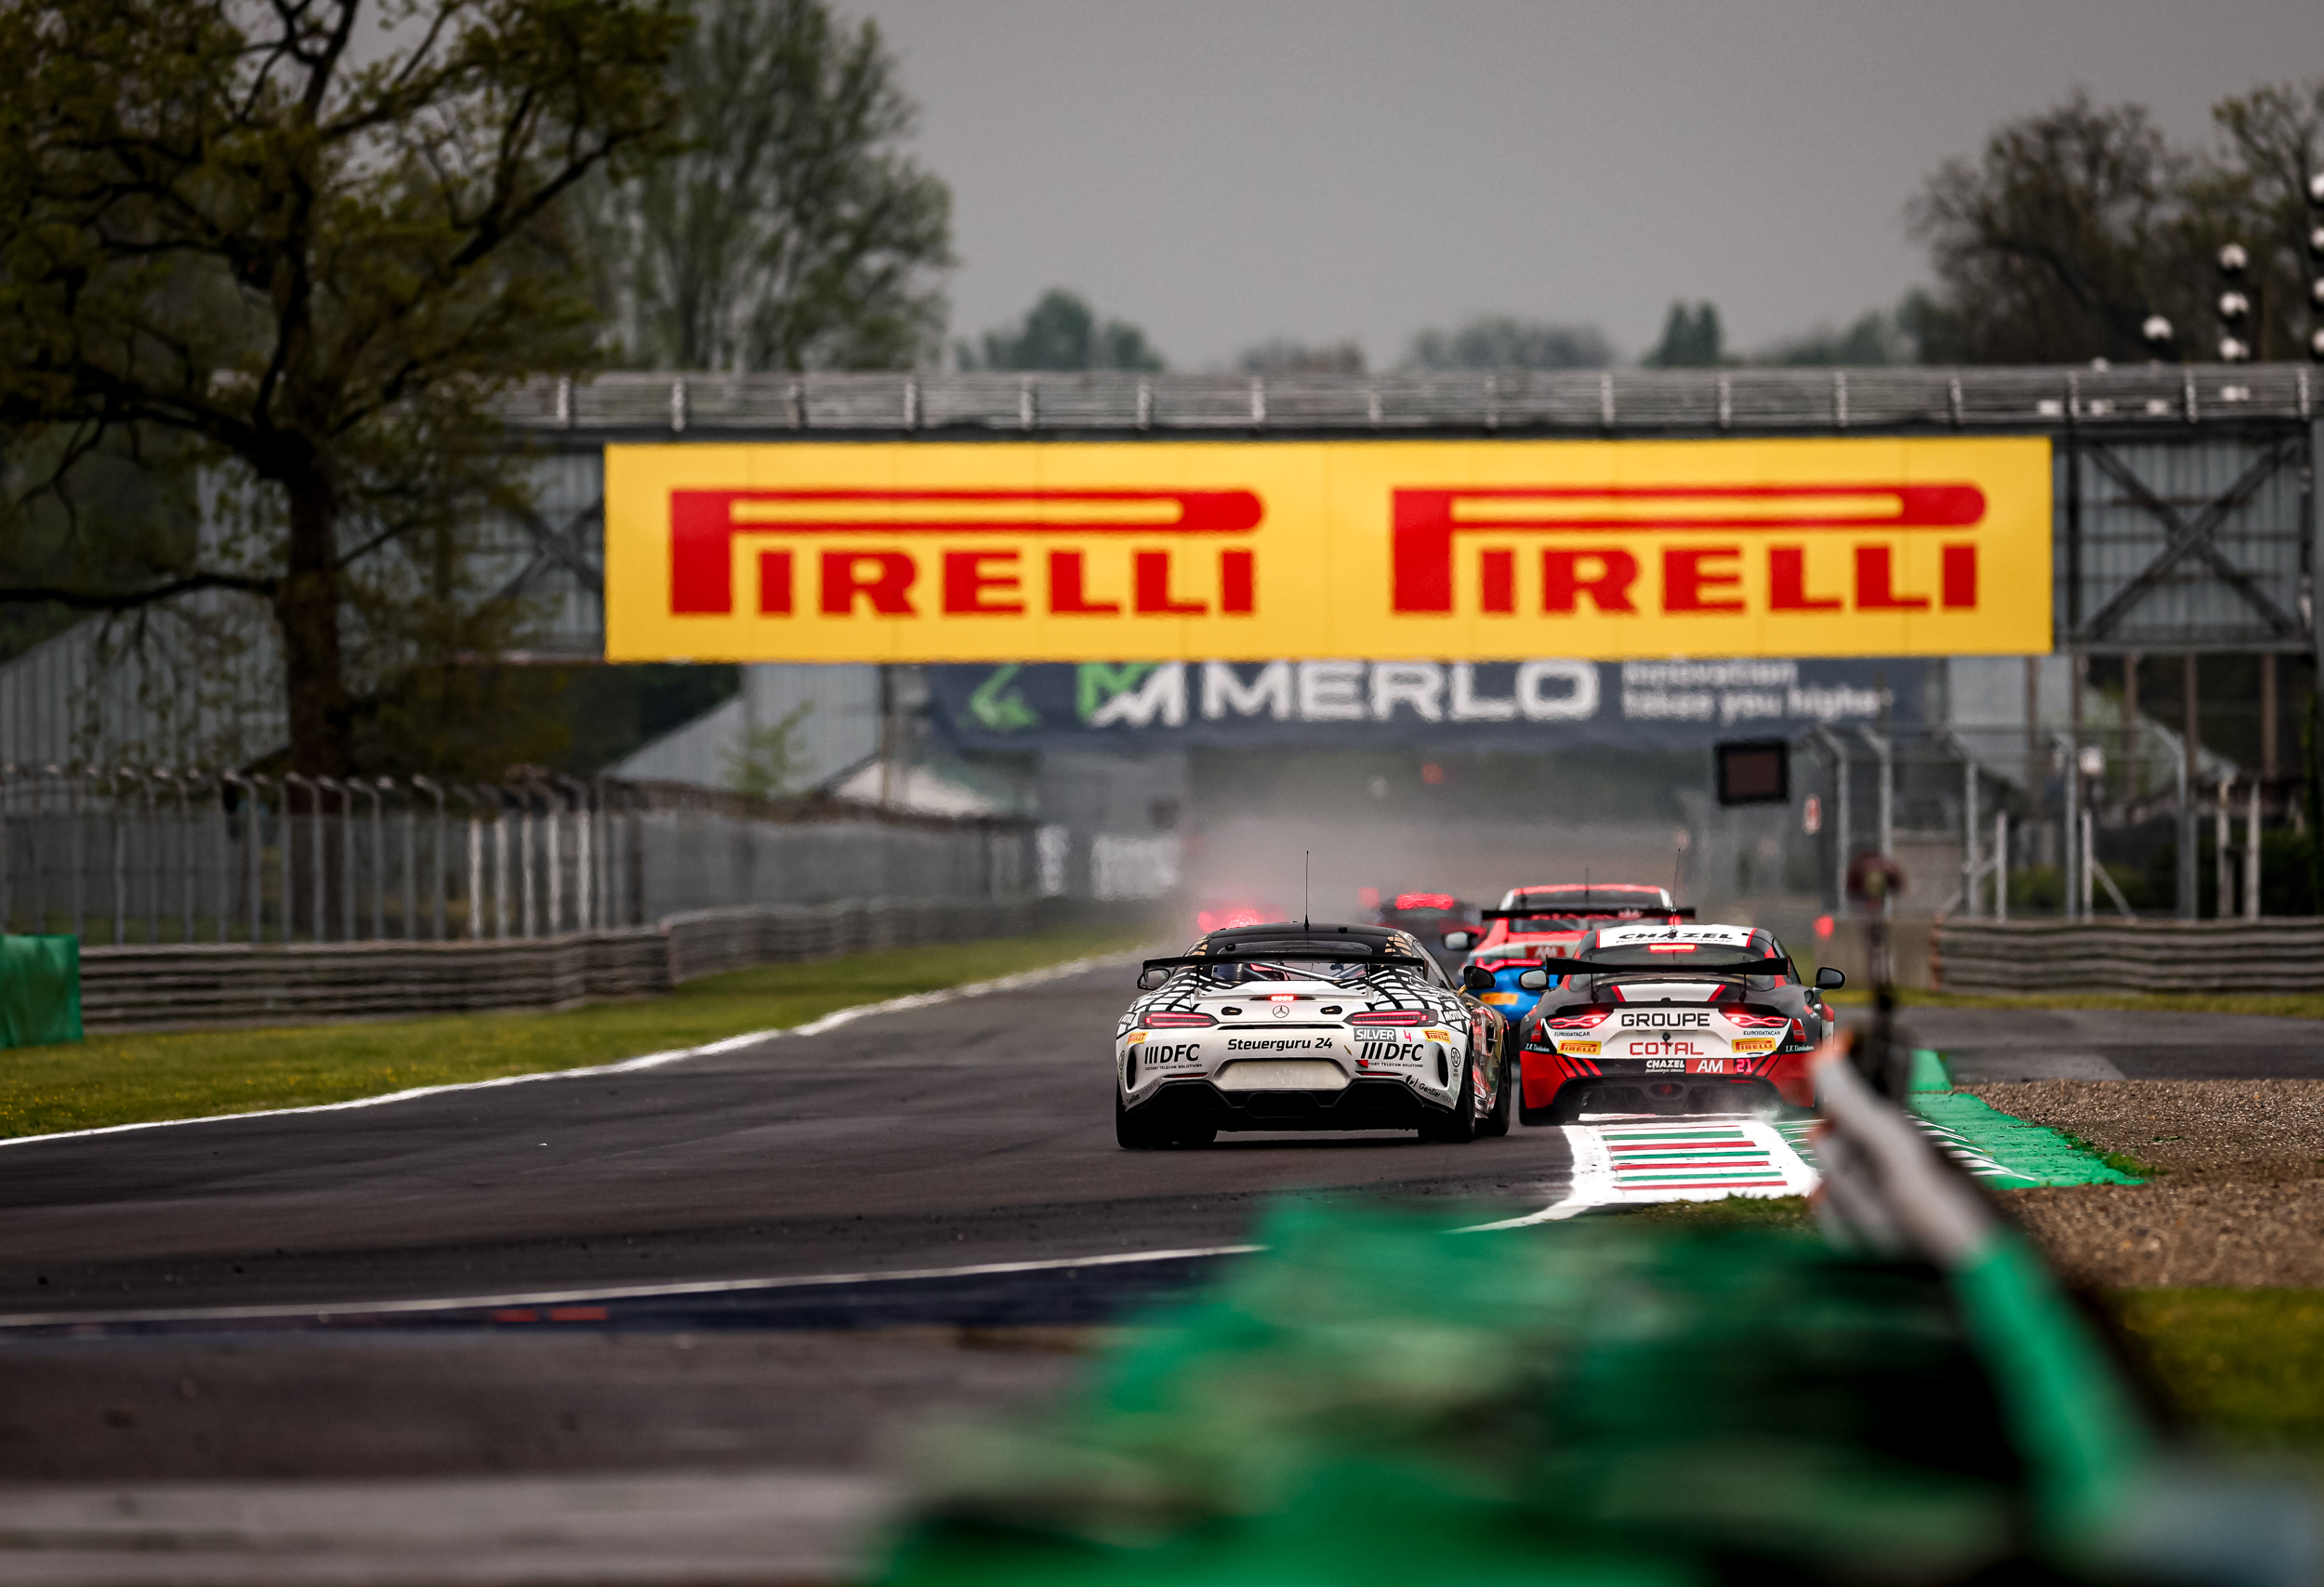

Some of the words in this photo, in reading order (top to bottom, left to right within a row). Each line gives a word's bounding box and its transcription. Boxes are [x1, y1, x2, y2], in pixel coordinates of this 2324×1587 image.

[669, 487, 1267, 616] PIRELLI
[1391, 482, 1987, 615] PIRELLI
[1202, 660, 1601, 722] MERLO
[1721, 692, 1783, 728] you
[1621, 1013, 1710, 1027] GROUPE
[1355, 1029, 1394, 1040] SILVER
[1424, 1030, 1449, 1042] PIRELLI
[1227, 1038, 1312, 1051] Steuerguru
[1314, 1038, 1333, 1049] 24
[1560, 1042, 1598, 1052] PIRELLI
[1630, 1041, 1704, 1055] COTAL
[1736, 1040, 1773, 1051] PIRELLI
[1645, 1060, 1685, 1068] CHAZEL
[1697, 1059, 1723, 1073] AM
[1736, 1058, 1753, 1073] 21
